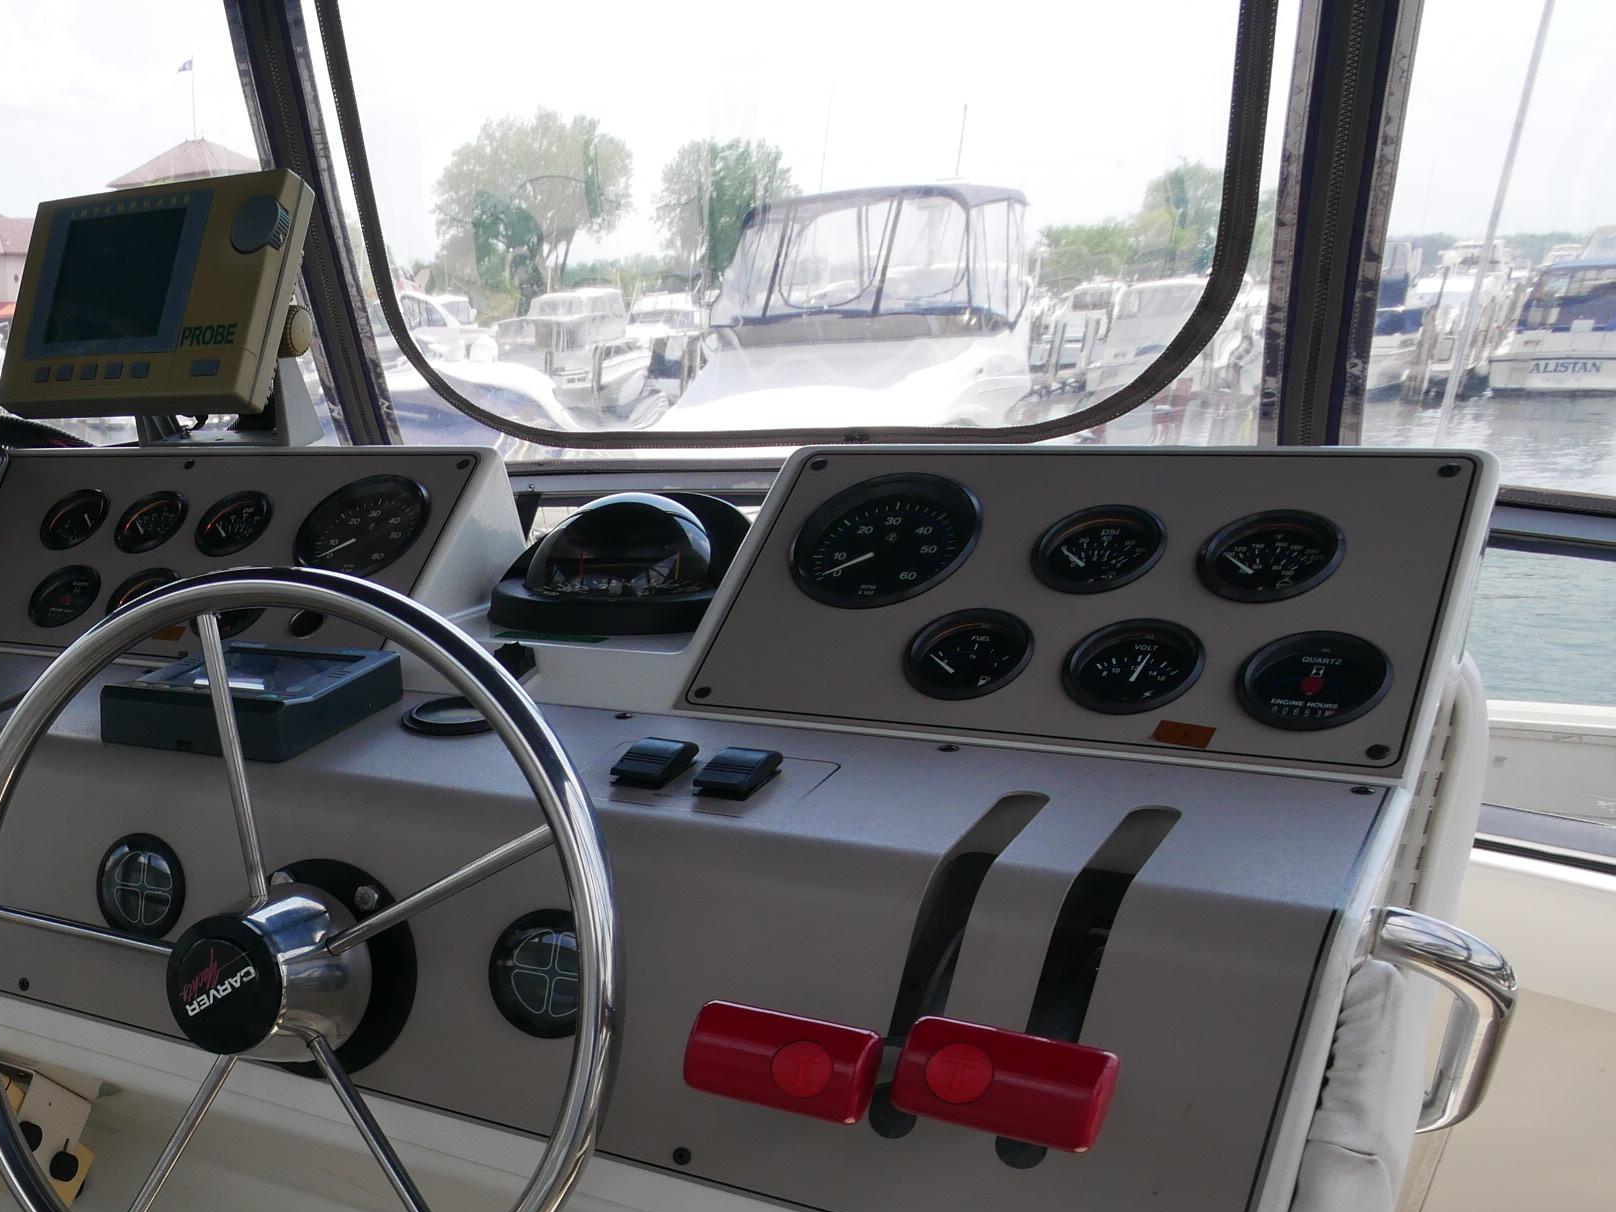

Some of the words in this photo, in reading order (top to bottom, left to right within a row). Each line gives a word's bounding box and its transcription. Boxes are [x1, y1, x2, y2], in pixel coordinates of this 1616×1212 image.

[180, 323, 237, 347] PROBE
[1528, 361, 1602, 374] ALISTAN
[884, 517, 902, 526] 30
[856, 526, 873, 535] 20
[915, 527, 933, 535] 40
[920, 545, 937, 554] 50
[833, 552, 847, 560] 10
[899, 572, 917, 580] 60
[1302, 656, 1344, 665] QUARTZ
[1270, 698, 1305, 706] ENGINE
[1306, 701, 1339, 709] HOURS
[185, 966, 256, 1017] CARVER
